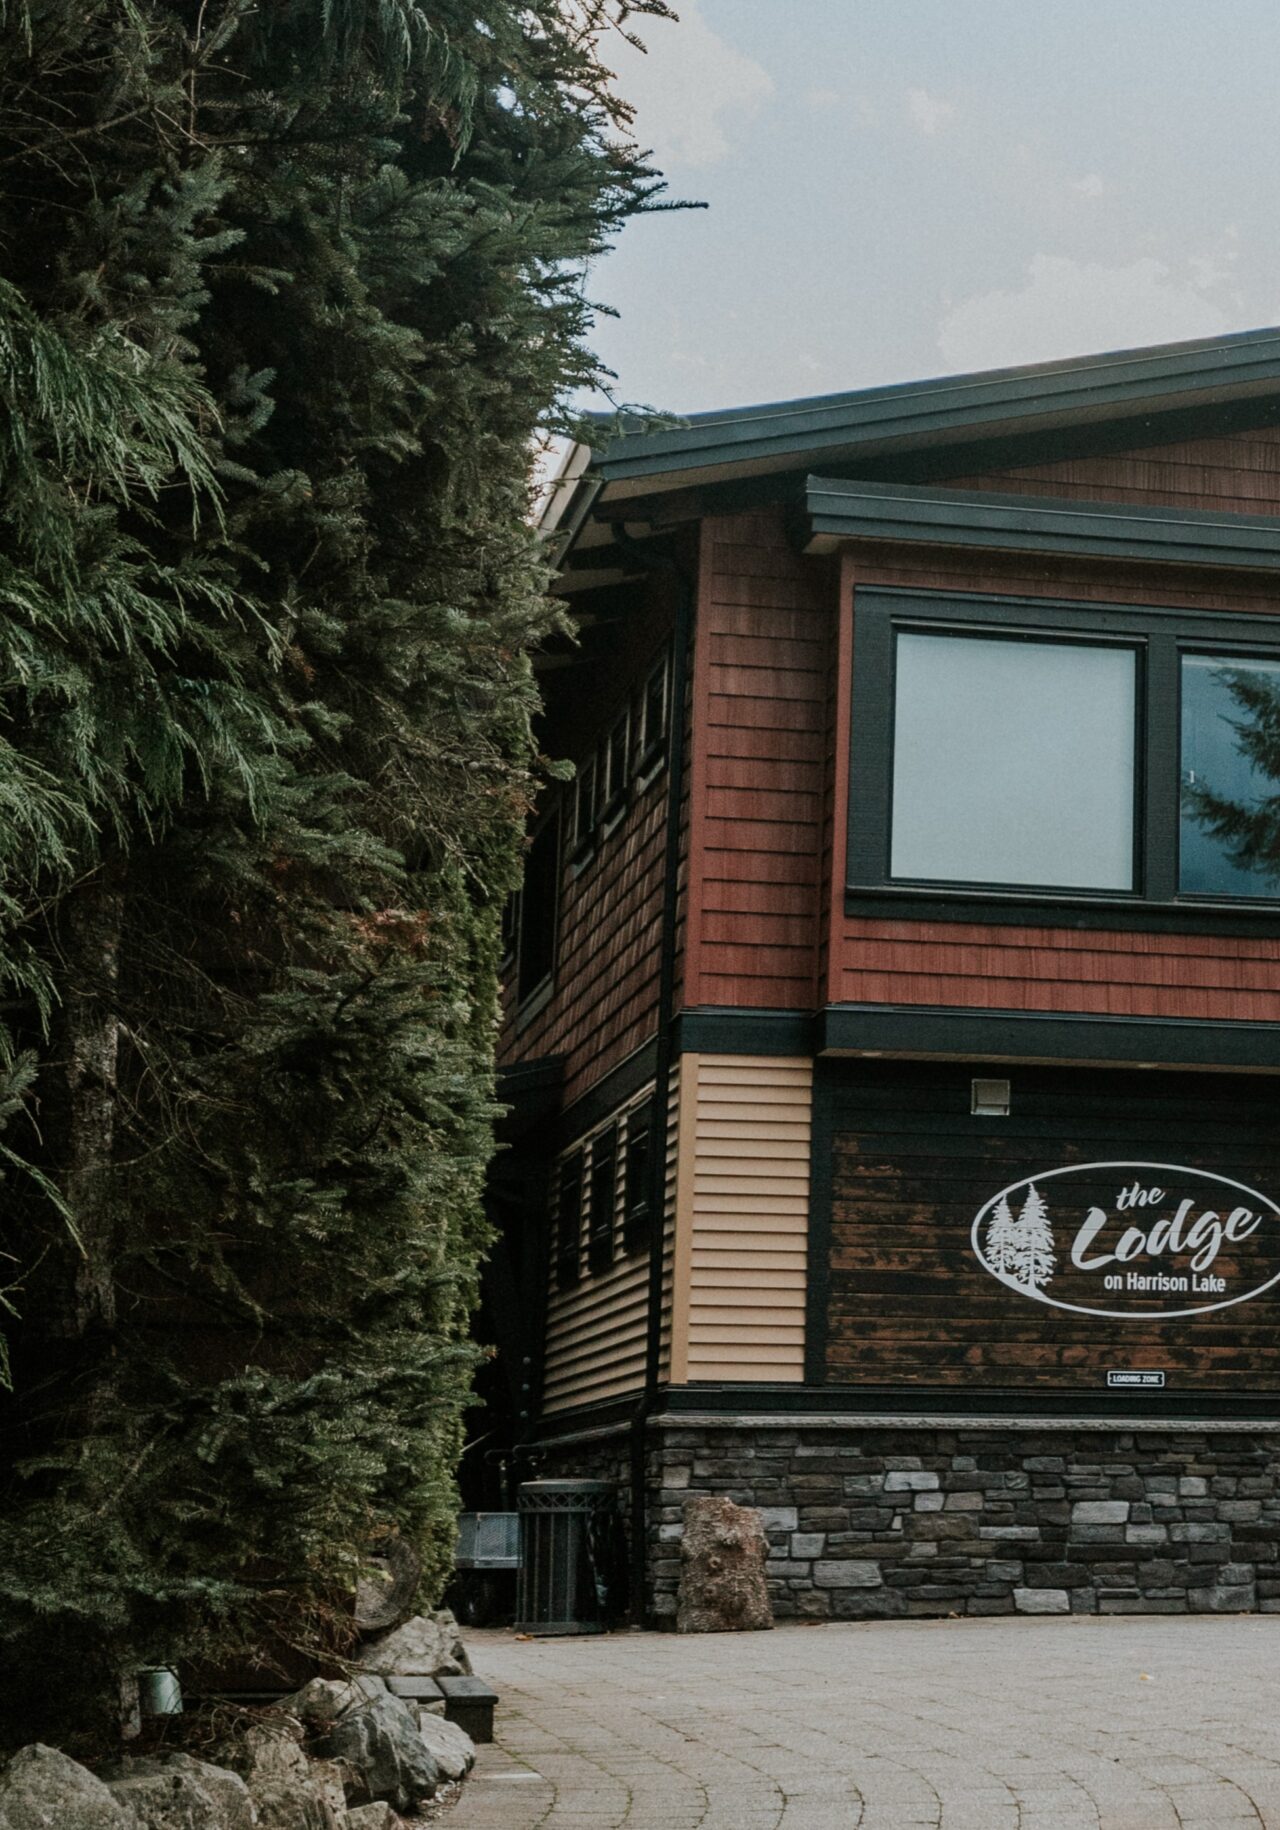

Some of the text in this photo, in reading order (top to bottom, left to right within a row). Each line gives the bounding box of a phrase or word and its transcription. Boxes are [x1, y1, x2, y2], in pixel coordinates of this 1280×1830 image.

[1116, 1181, 1166, 1211] the
[1071, 1198, 1262, 1272] Lodge
[1104, 1272, 1226, 1292] on Harrison Lake
[1113, 1374, 1160, 1383] LOADING ZONE
